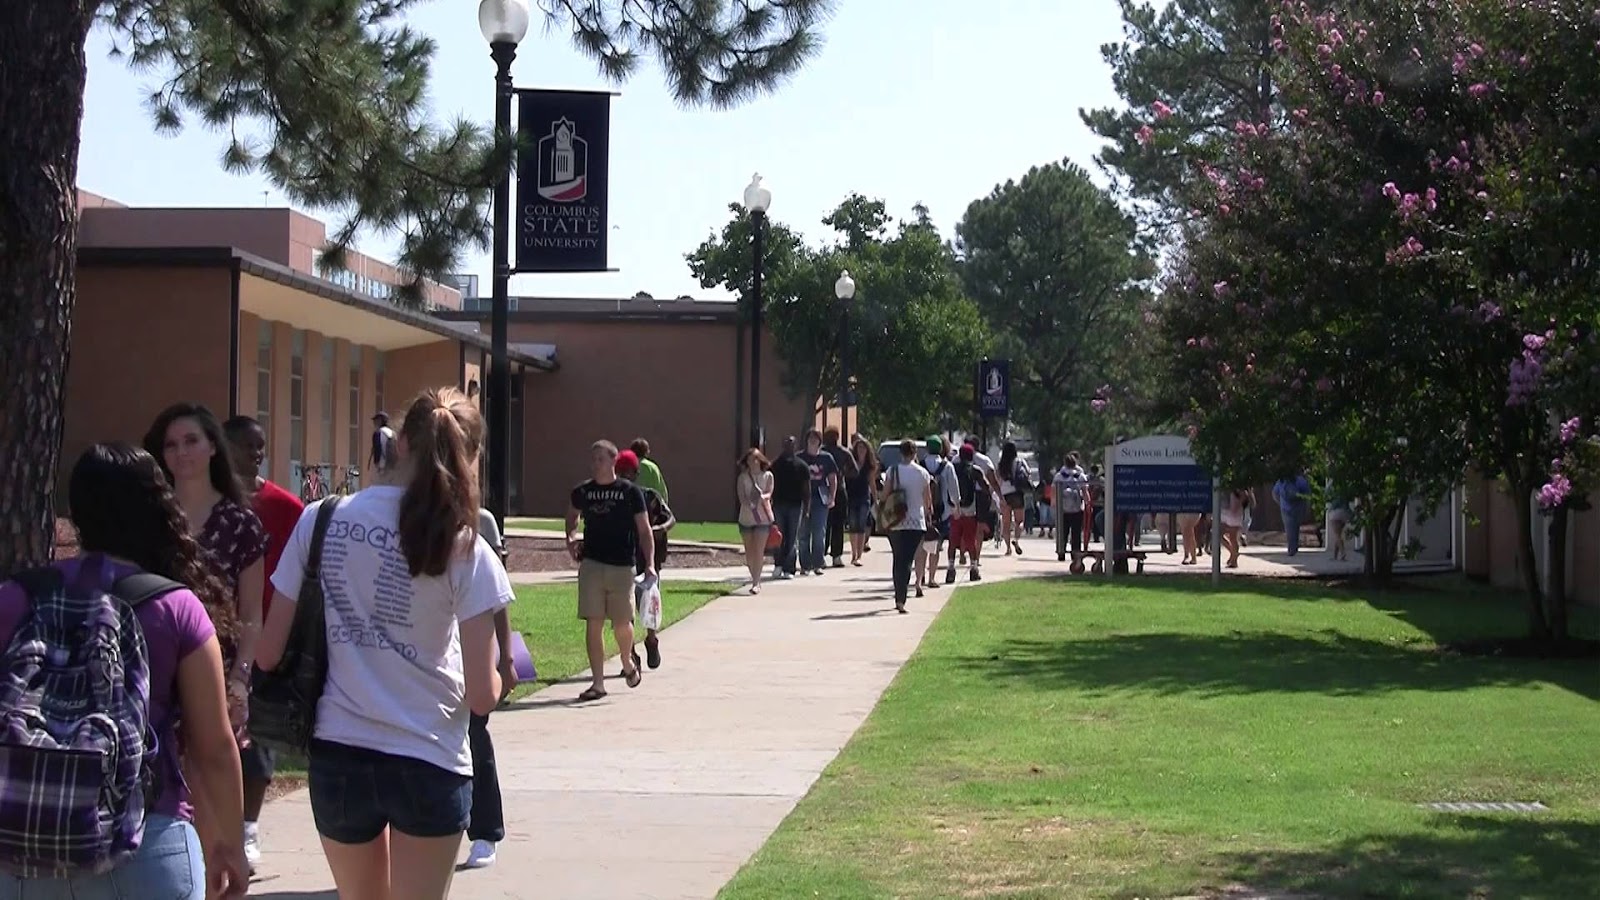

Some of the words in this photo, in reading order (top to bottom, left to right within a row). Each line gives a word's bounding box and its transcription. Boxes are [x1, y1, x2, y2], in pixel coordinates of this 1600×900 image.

[524, 204, 600, 217] COLUMBUS
[524, 216, 600, 234] STATE
[524, 237, 599, 249] UNIVERSITY
[581, 488, 625, 500] OLLISTER
